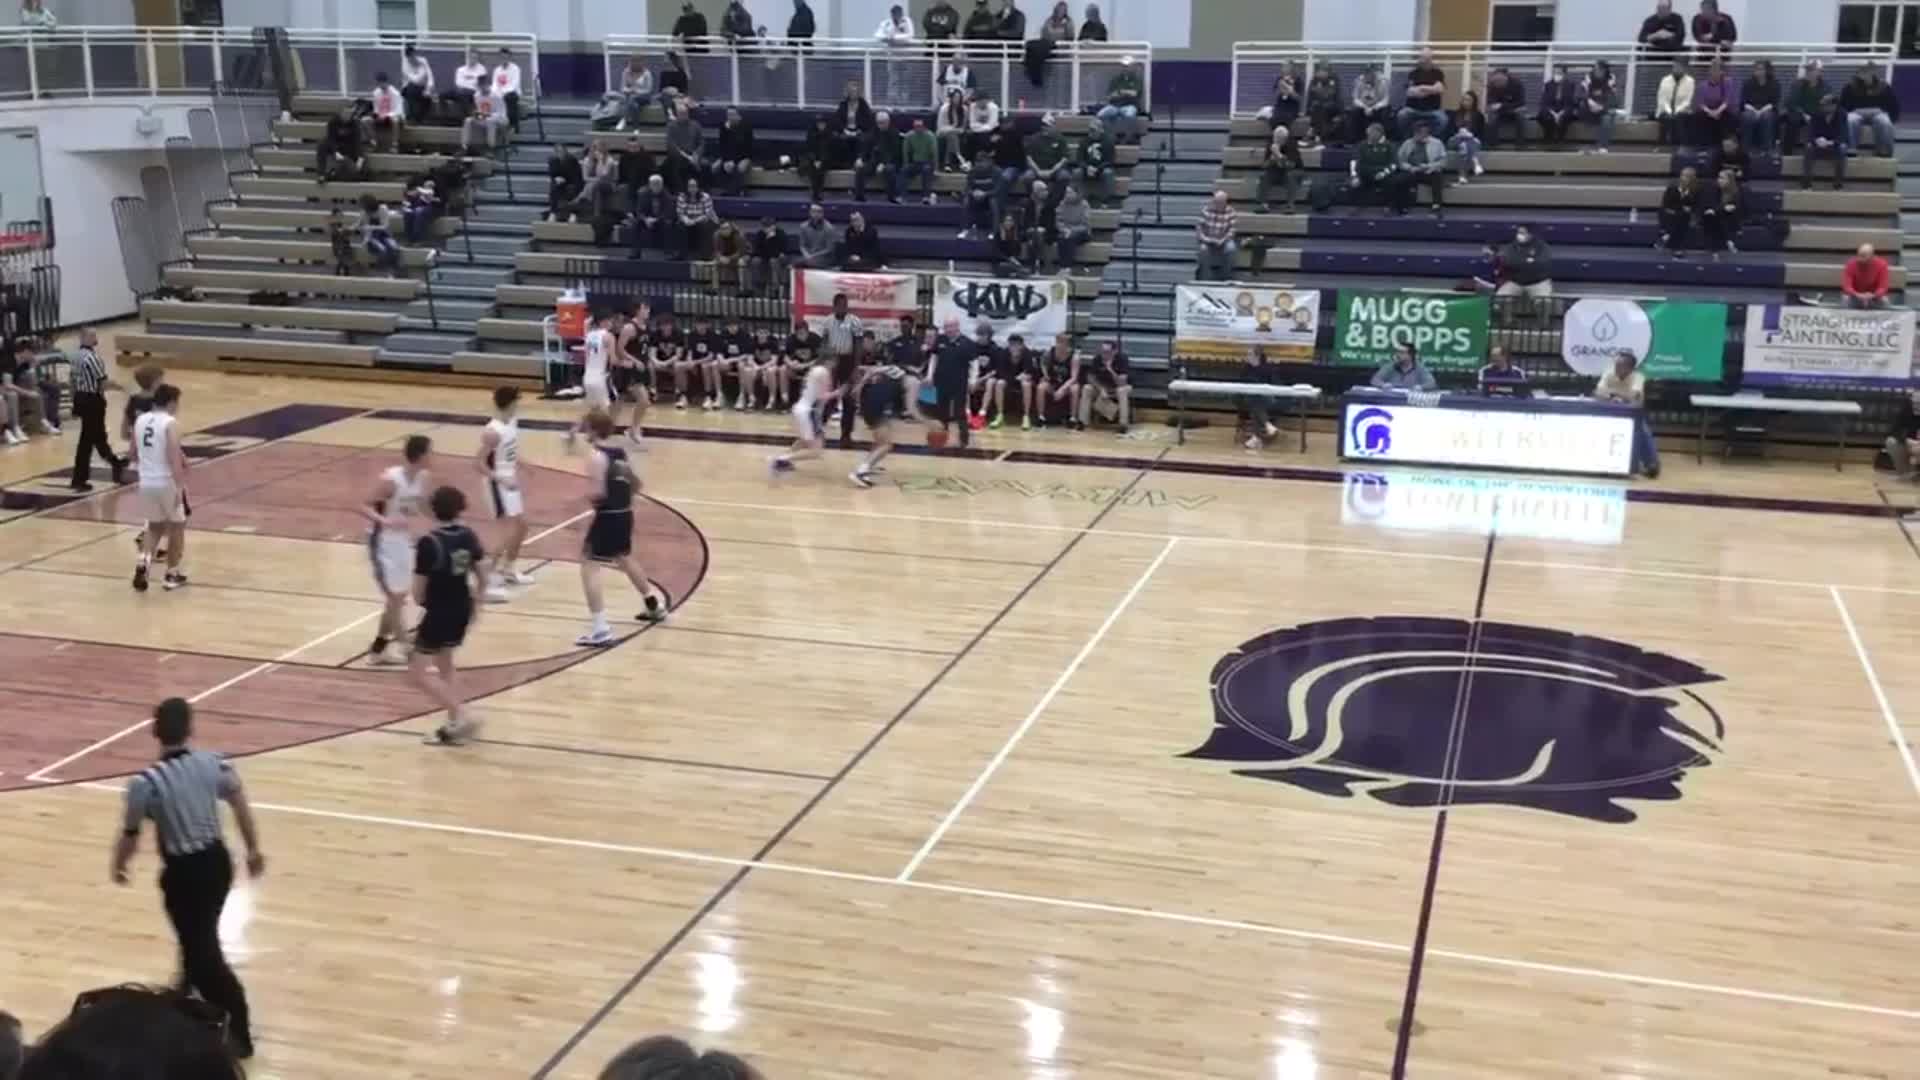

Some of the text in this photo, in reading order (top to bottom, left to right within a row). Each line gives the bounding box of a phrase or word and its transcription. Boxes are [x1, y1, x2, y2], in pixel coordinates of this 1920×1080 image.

[967, 282, 1034, 319] KW
[1351, 296, 1447, 324] MUGG
[1345, 322, 1471, 352] & BOPPS
[1868, 333, 1900, 348] LLC
[1571, 344, 1634, 357] GRANG
[144, 427, 155, 447] 2
